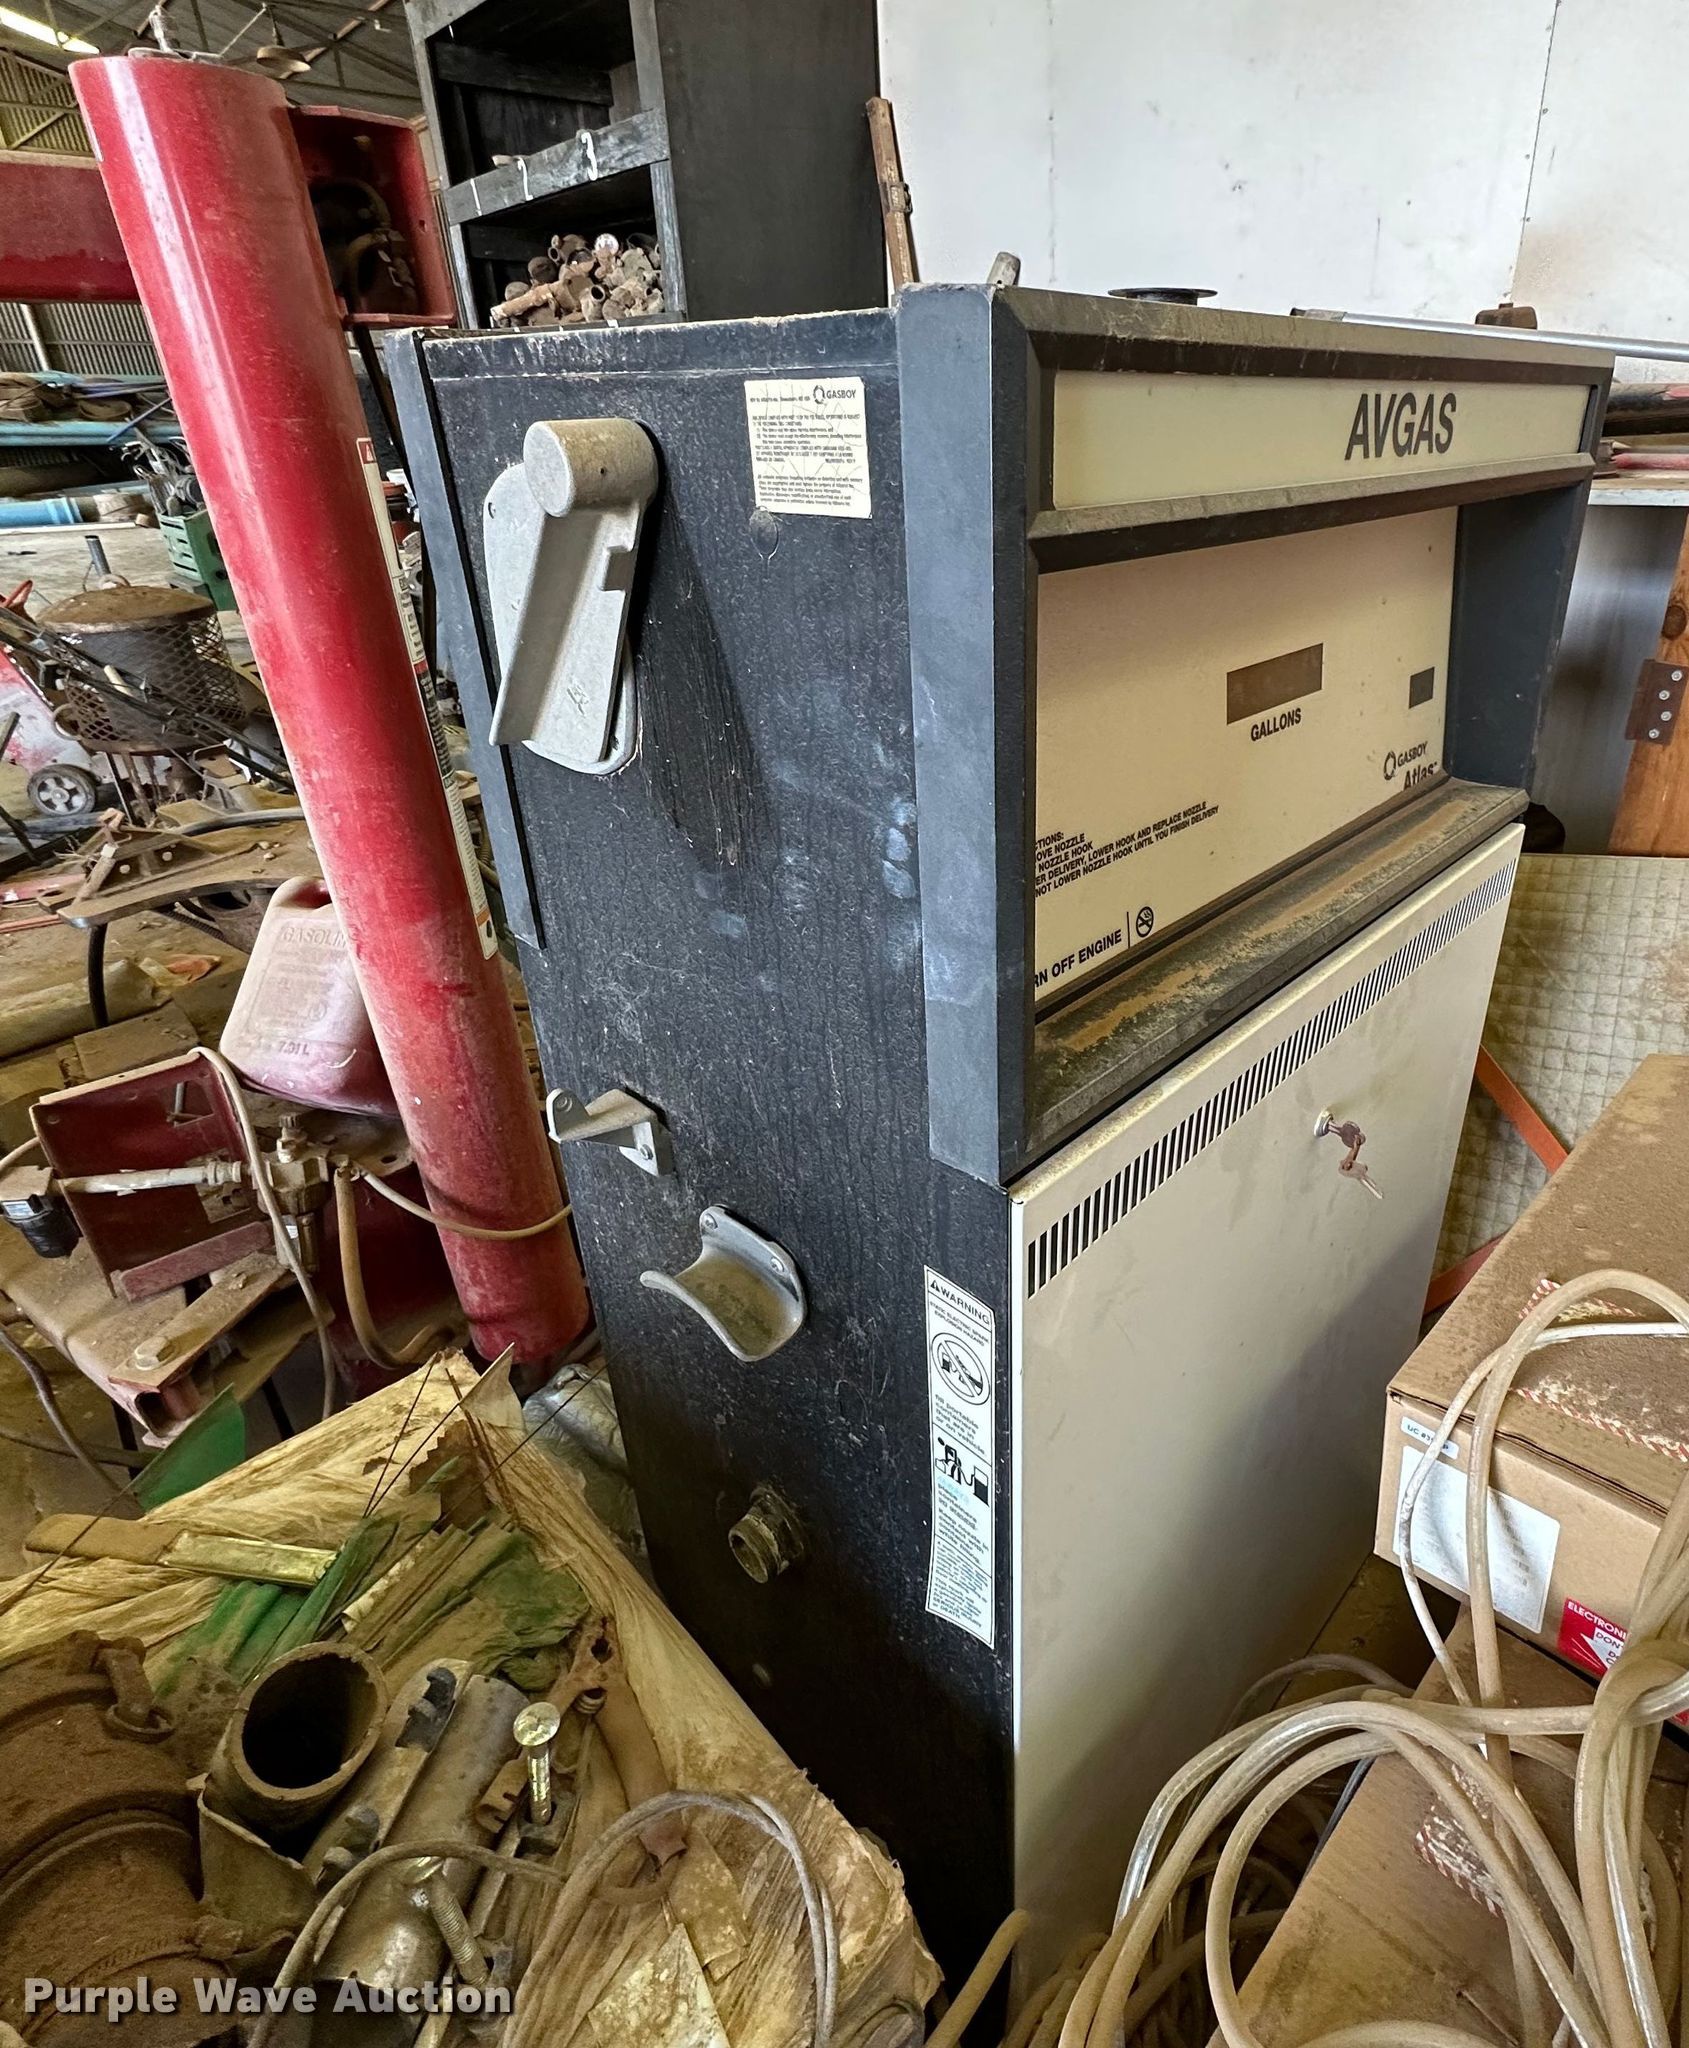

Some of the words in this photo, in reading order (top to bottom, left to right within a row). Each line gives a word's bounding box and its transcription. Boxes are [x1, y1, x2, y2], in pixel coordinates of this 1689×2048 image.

[827, 389, 856, 400] GASBOY
[1344, 392, 1457, 460] AVGAS
[1250, 708, 1302, 742] GALLONS
[1398, 741, 1428, 767] GASBOY
[1404, 764, 1434, 790] Atlas
[1035, 882, 1052, 898] NOT
[1054, 870, 1081, 888] LOWER
[1083, 855, 1111, 876] NOZZLE
[1112, 845, 1134, 862] HOOK
[1134, 836, 1154, 851] UNTIL
[1155, 828, 1168, 841] YOU
[1170, 819, 1190, 835] FINISH
[1191, 805, 1218, 825] DELIVERY
[1038, 851, 1070, 872] NOZZLE
[1072, 841, 1093, 858] HOOK
[1048, 855, 1086, 880] DELIVERY,
[1088, 843, 1114, 862] LOWER
[1116, 833, 1136, 850] HOOK
[1137, 826, 1151, 840] AND
[1152, 812, 1182, 832] REPLACE
[1183, 801, 1206, 818] NOZZLE
[1055, 833, 1084, 854] NOZZLE
[1052, 954, 1075, 978] OFF
[1078, 929, 1122, 964] ENGINE
[940, 1285, 990, 1325] WARNING
[1567, 1601, 1627, 1640] ELECTRONI
[1595, 1632, 1623, 1649] DON
